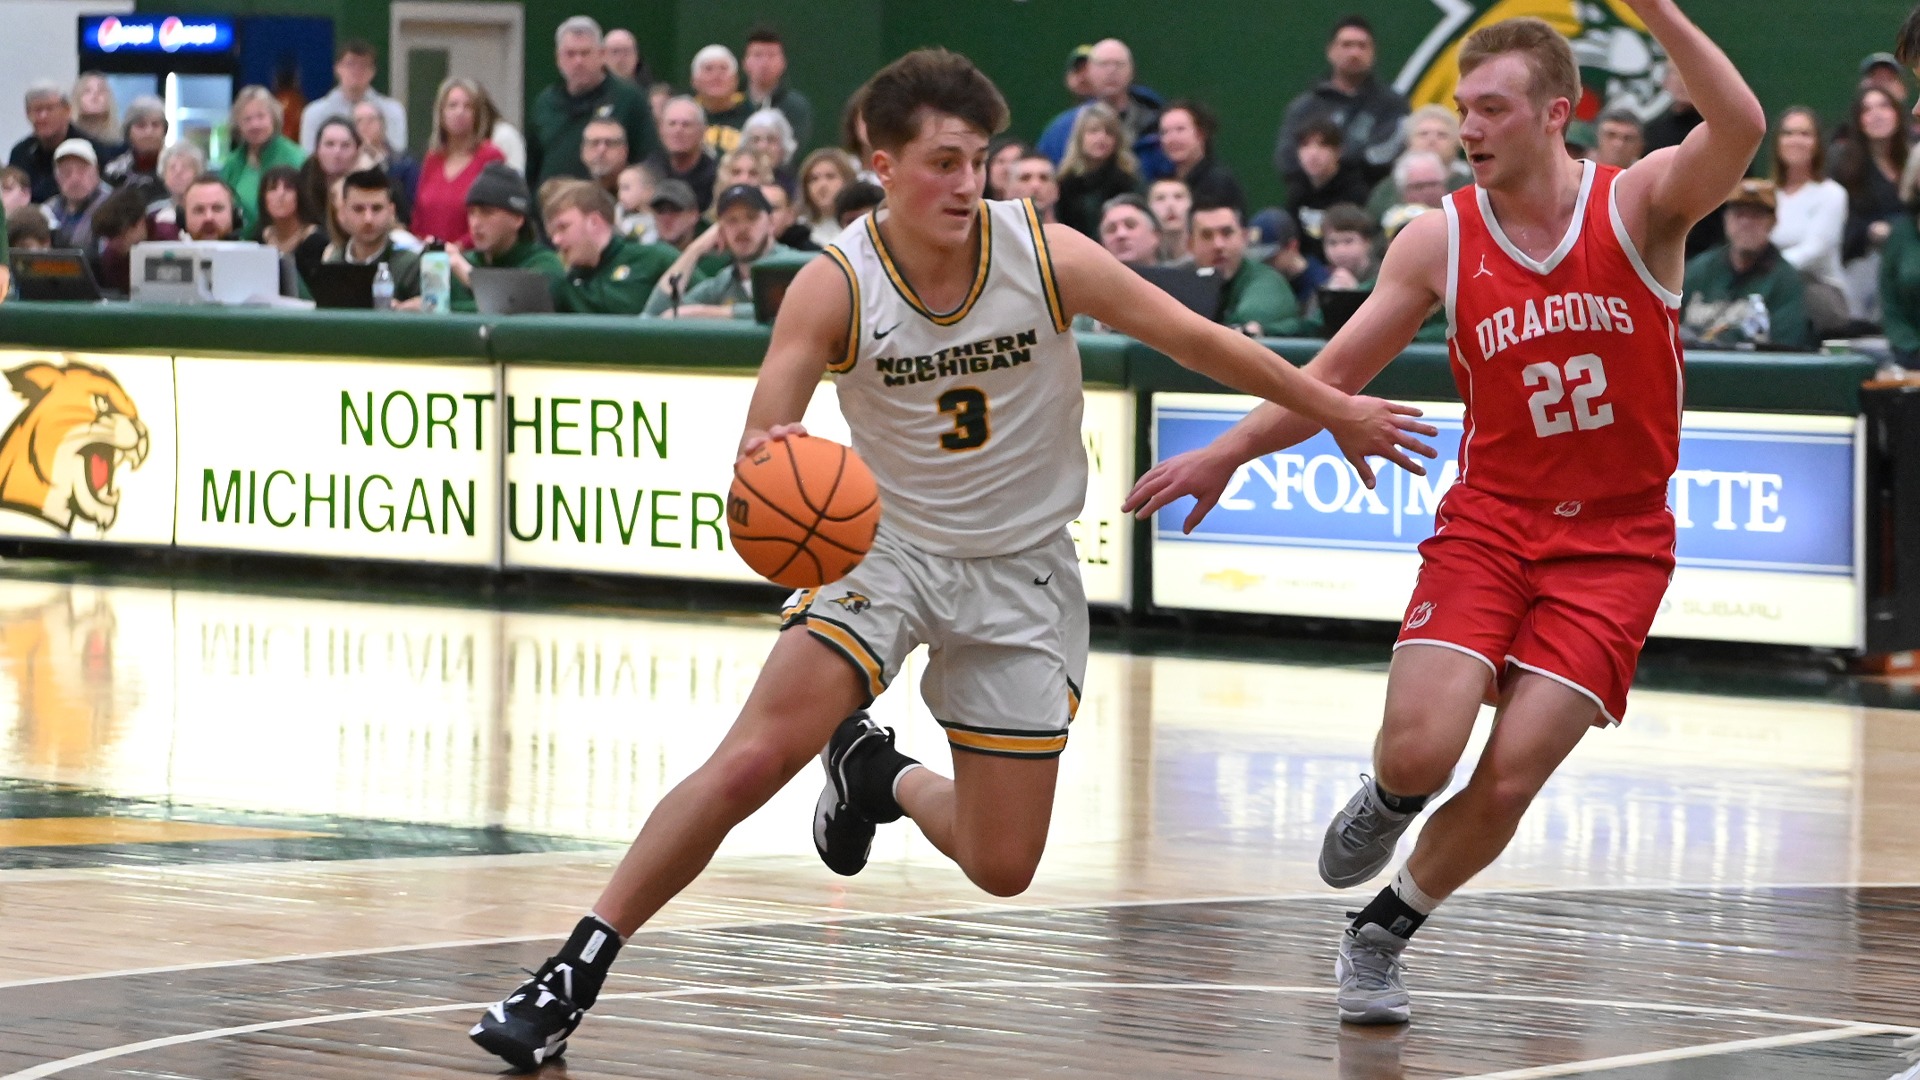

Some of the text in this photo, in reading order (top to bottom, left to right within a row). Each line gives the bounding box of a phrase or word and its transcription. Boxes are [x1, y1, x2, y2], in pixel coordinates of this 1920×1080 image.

[876, 328, 1037, 374] NORTHERN
[1475, 292, 1634, 362] DRAGONS
[883, 348, 1031, 387] MICHIGAN
[1521, 352, 1615, 438] 22
[340, 390, 668, 459] NORTHERN
[936, 385, 991, 453] 3
[201, 468, 475, 537] MICHIGAN
[508, 481, 725, 551] UNIVER
